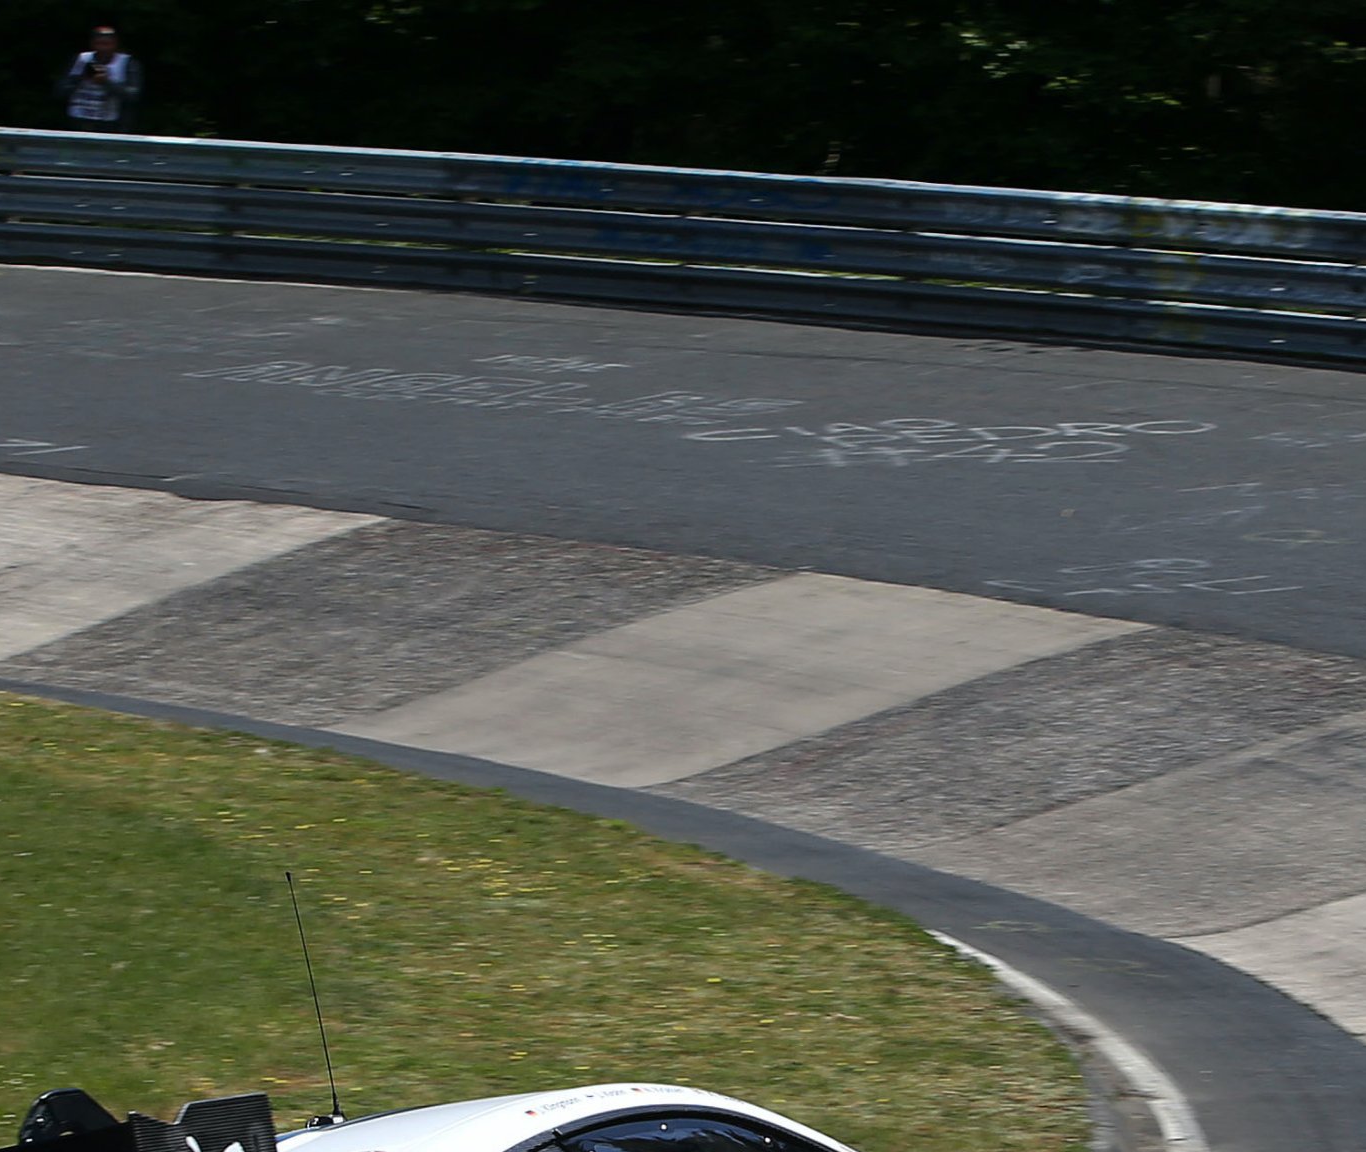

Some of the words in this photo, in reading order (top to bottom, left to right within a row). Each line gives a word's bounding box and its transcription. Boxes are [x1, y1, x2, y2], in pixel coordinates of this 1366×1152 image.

[183, 361, 587, 406] ANGEL
[681, 418, 961, 442] CIAO
[819, 420, 1217, 448] PEDRO
